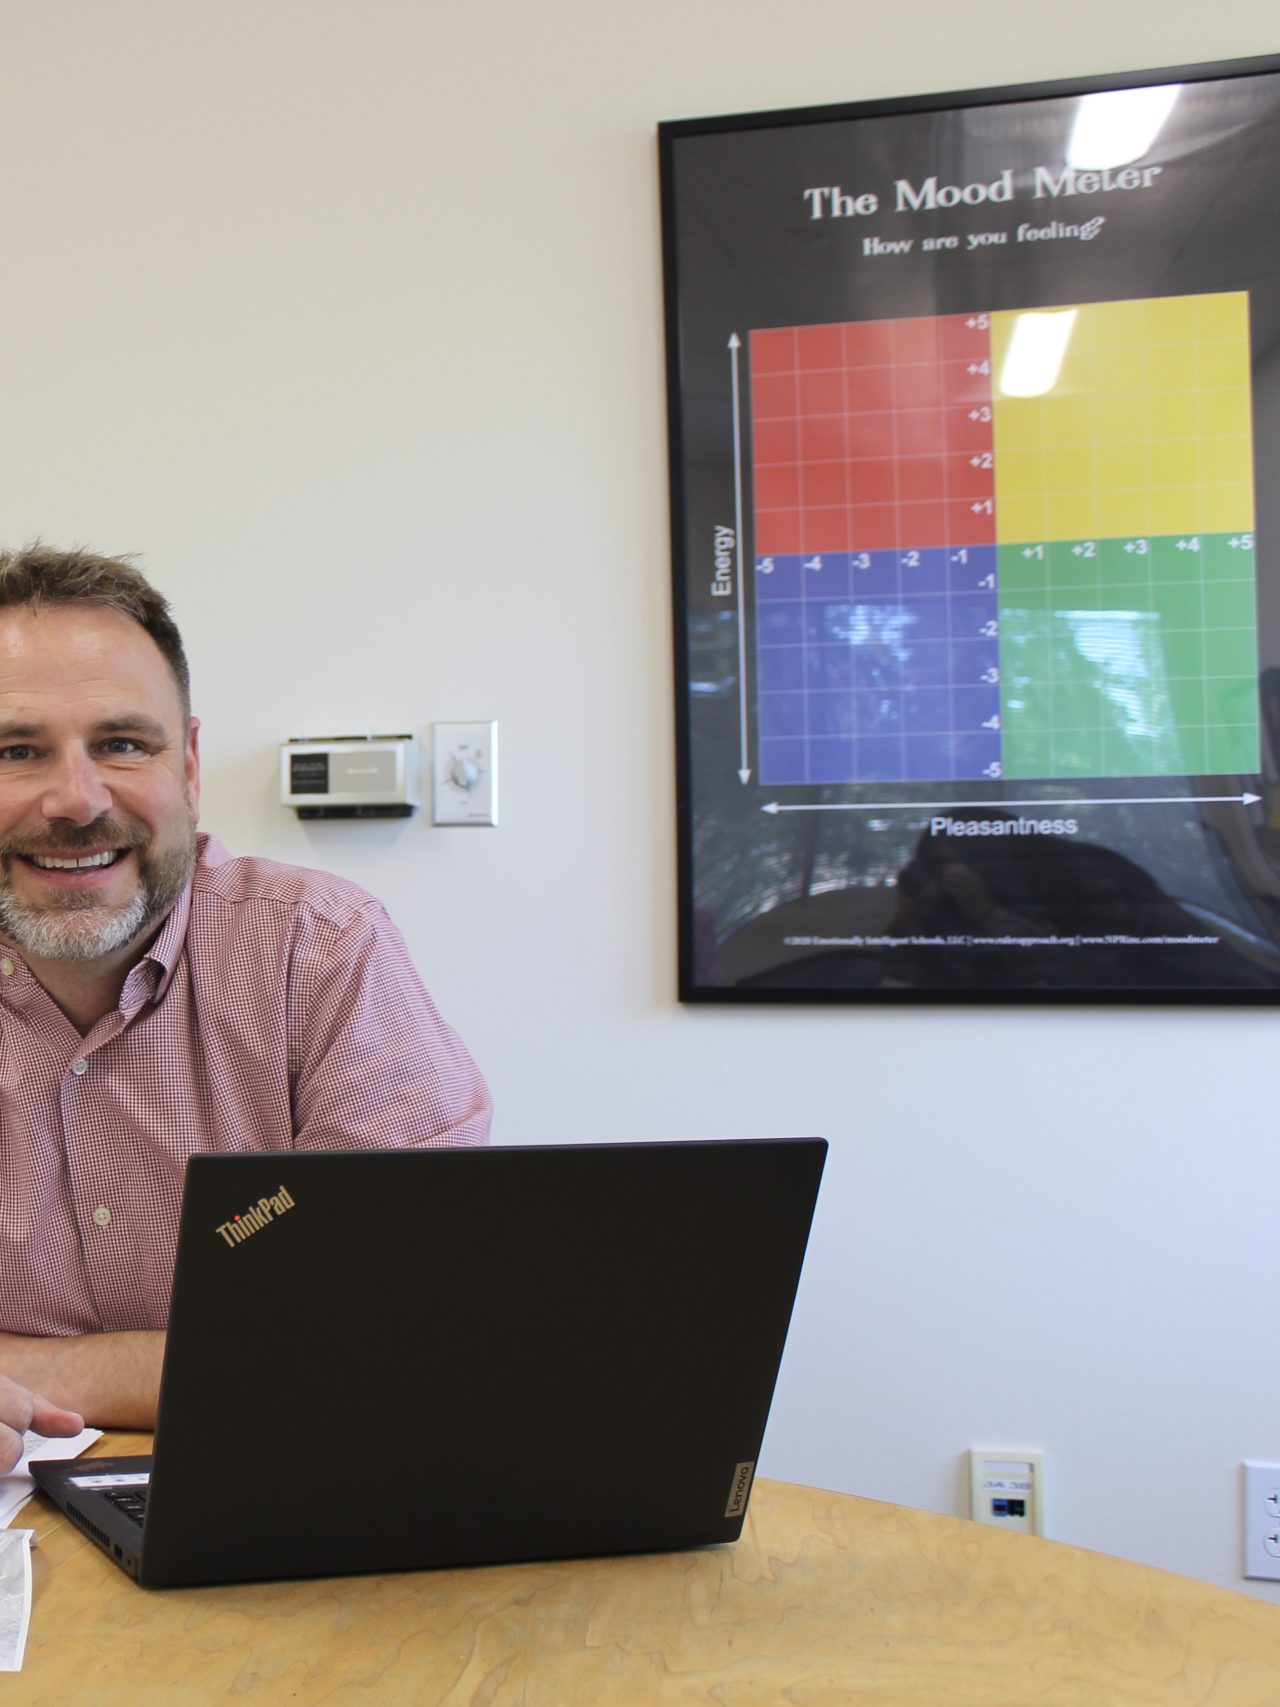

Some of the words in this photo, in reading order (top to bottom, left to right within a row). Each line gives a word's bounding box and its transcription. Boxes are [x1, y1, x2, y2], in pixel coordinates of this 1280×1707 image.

[803, 186, 879, 220] The
[894, 169, 1014, 212] Mood
[1033, 166, 1163, 199] Meter
[862, 237, 914, 256] How
[922, 235, 959, 251] are
[967, 231, 1008, 250] you
[1017, 215, 1106, 242] feeling?
[965, 314, 989, 330] +5
[966, 360, 990, 376] +4
[968, 406, 992, 423] +3
[969, 453, 993, 469] +2
[970, 500, 993, 516] +1
[1071, 542, 1096, 558] +2
[1123, 539, 1148, 555] +3
[1175, 537, 1201, 552] +4
[1227, 535, 1253, 549] +5
[711, 525, 735, 596] Energy
[1022, 545, 1044, 560] +1
[930, 816, 1079, 836] Pleasantness
[216, 1185, 295, 1248] ThinkPad
[729, 1466, 749, 1513] Lenovo
